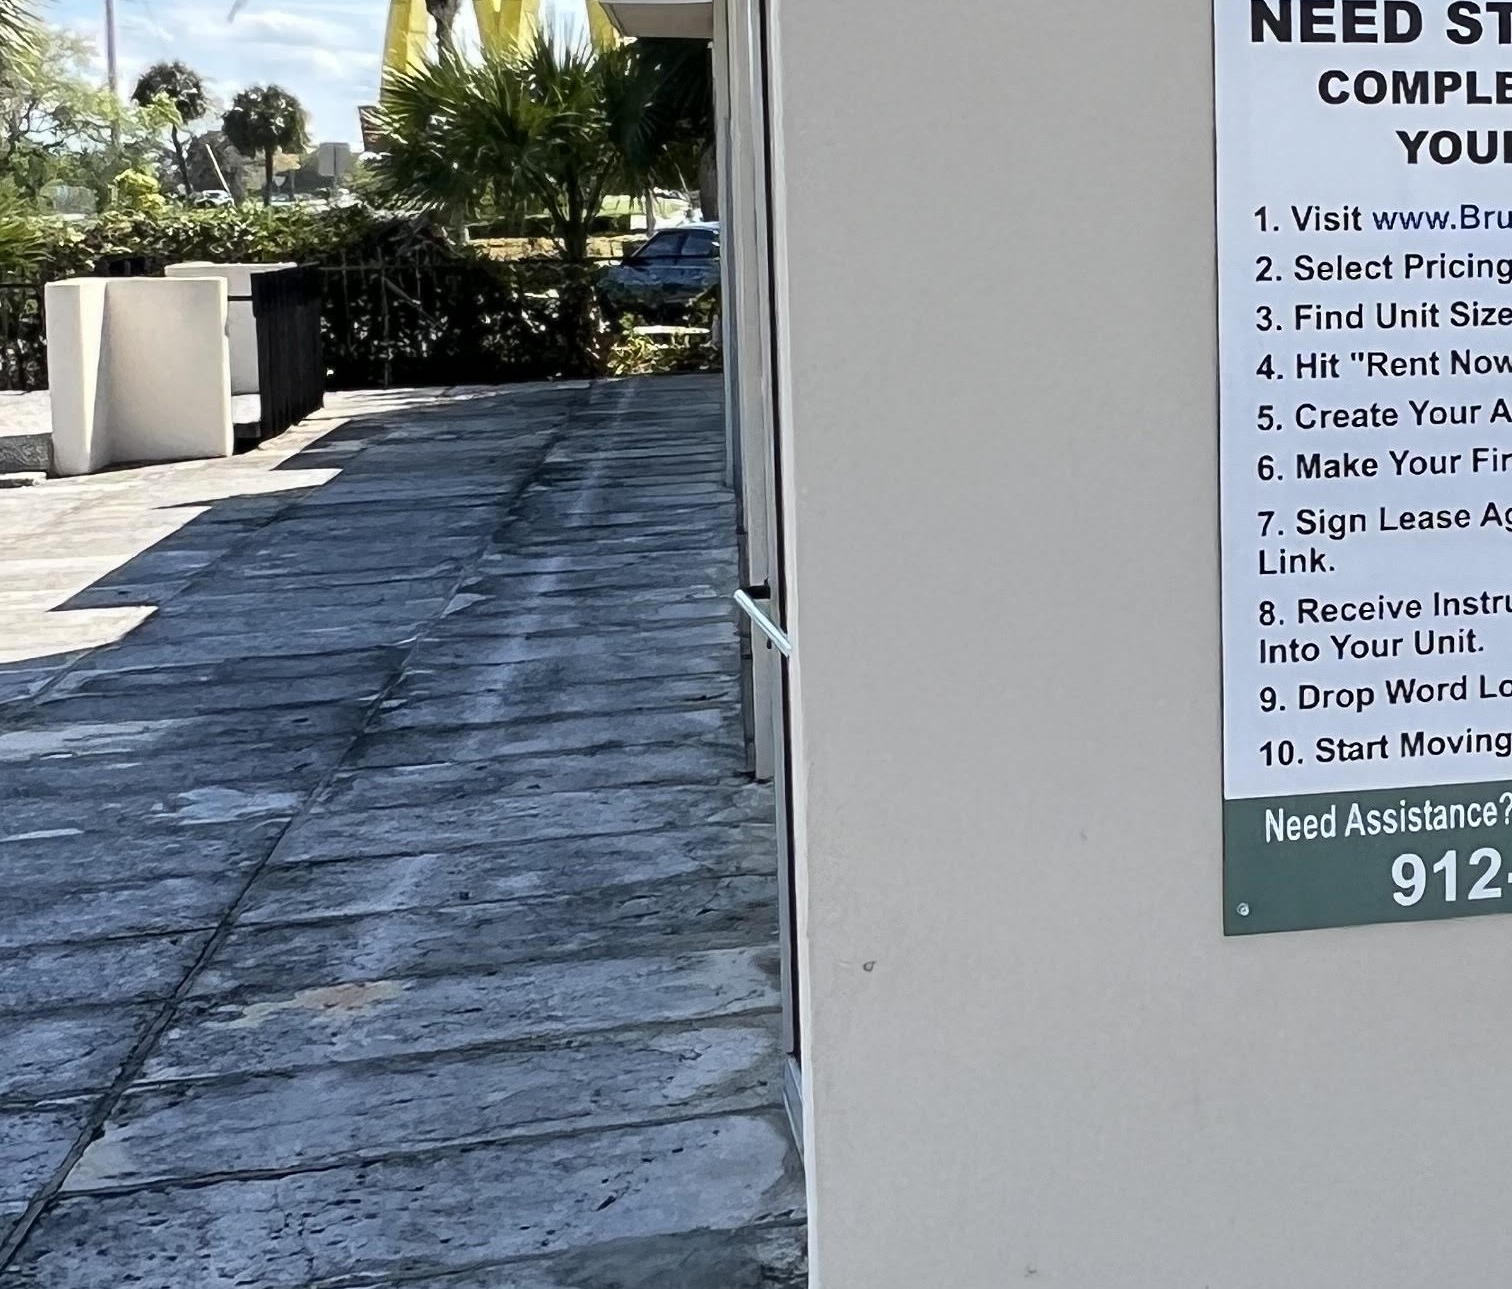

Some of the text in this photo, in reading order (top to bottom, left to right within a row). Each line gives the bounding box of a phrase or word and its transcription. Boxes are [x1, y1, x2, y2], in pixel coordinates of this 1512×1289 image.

[1251, 0, 1422, 43] NEED
[1255, 206, 1278, 231] 1.
[1291, 206, 1362, 231] Visit
[1256, 256, 1281, 281] 2.
[1295, 255, 1392, 280] Select
[1405, 253, 1512, 284] Pricing
[1256, 306, 1282, 331] 3.
[1295, 303, 1363, 330] Find
[1377, 302, 1439, 328] Unit
[1256, 354, 1283, 379] 4.
[1297, 353, 1339, 379] Hit
[1351, 352, 1439, 377] "Rent
[1258, 405, 1282, 430] 5.
[1296, 403, 1398, 429] Create
[1409, 400, 1481, 425] Your
[1258, 455, 1283, 480] 6.
[1297, 453, 1378, 478] Make
[1389, 450, 1461, 475] Your
[1258, 511, 1283, 536] 7.
[1297, 509, 1366, 540] Sign
[1380, 507, 1470, 531] Lease
[1260, 548, 1334, 574] Link.
[1260, 601, 1284, 625] 8.
[1298, 595, 1422, 623] Receive
[1261, 629, 1483, 663] Into Your Unit.
[1260, 687, 1285, 712] 9.
[1299, 685, 1374, 713] Drop
[1386, 675, 1466, 704] Word
[1260, 741, 1303, 766] 10.
[1316, 735, 1388, 762] Start
[1401, 728, 1511, 757] Moving
[1266, 805, 1336, 842] Need
